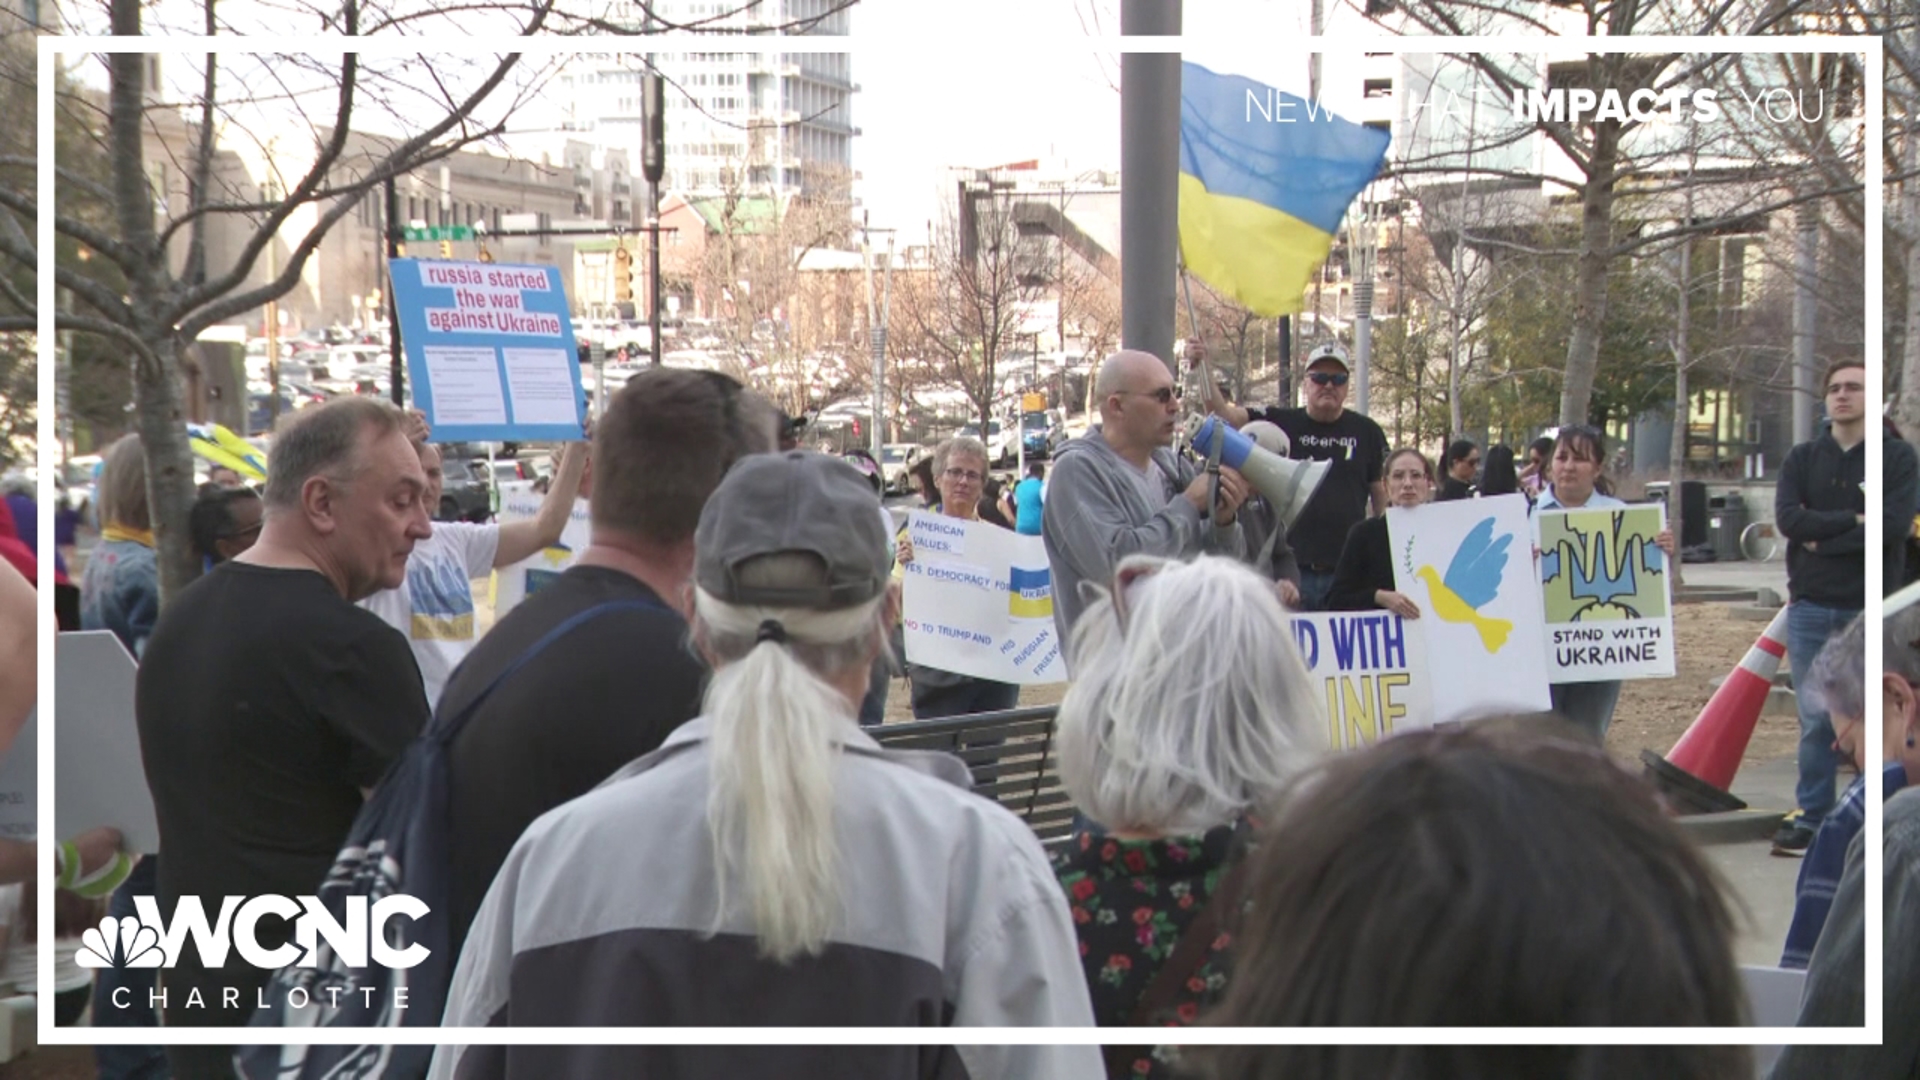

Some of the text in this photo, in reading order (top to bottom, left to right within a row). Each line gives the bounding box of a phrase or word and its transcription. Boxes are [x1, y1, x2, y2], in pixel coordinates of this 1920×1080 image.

[429, 265, 547, 290] russia started
[456, 289, 520, 309] the war
[430, 309, 560, 334] against Ukraine
[914, 519, 965, 537] AMERICAN
[927, 566, 991, 587] DEMOCRACY
[904, 618, 992, 646] NO TO TRUMP AND
[1328, 614, 1407, 671] WITH
[1553, 626, 1661, 644] STAND WITH
[1012, 629, 1049, 667] RUSSIAN
[1557, 641, 1657, 668] UKRAINE
